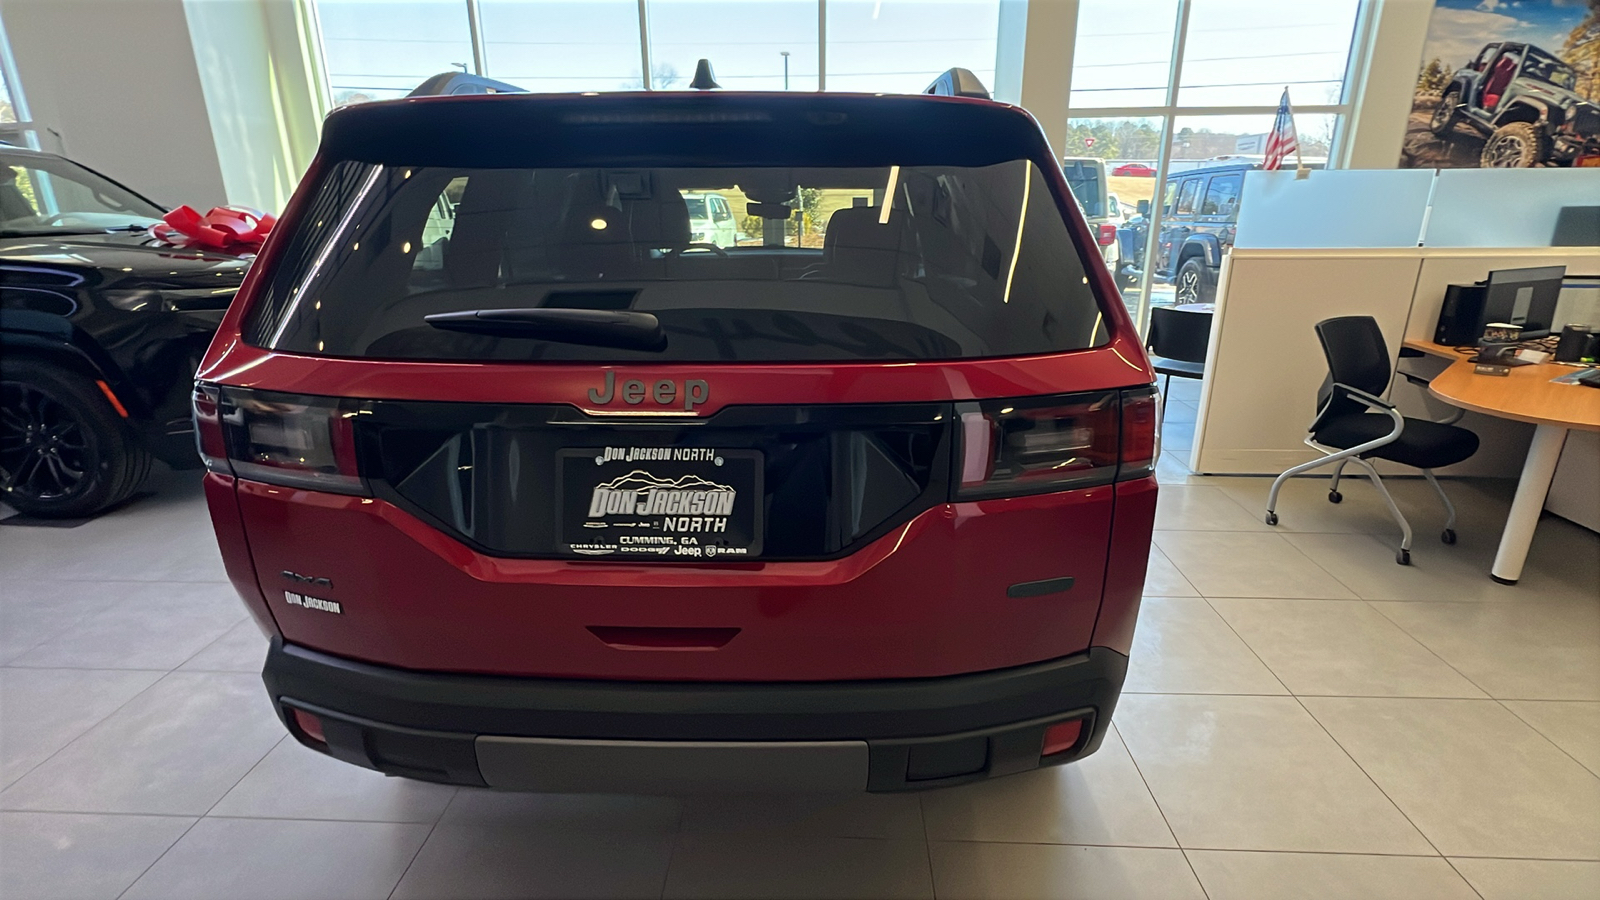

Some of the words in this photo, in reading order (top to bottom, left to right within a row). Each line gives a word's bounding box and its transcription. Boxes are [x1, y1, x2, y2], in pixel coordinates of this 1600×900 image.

[588, 370, 709, 411] Jeep
[604, 446, 626, 462] DON
[626, 446, 672, 462] JACKSON
[673, 448, 715, 461] NORTH
[588, 488, 638, 517] DON
[636, 489, 736, 516] JACKSON
[663, 517, 727, 532] NORTH
[620, 536, 677, 545] CUMMING,
[681, 536, 698, 545] GA
[674, 545, 702, 557] Jeep
[303, 595, 341, 614] JACKSON
